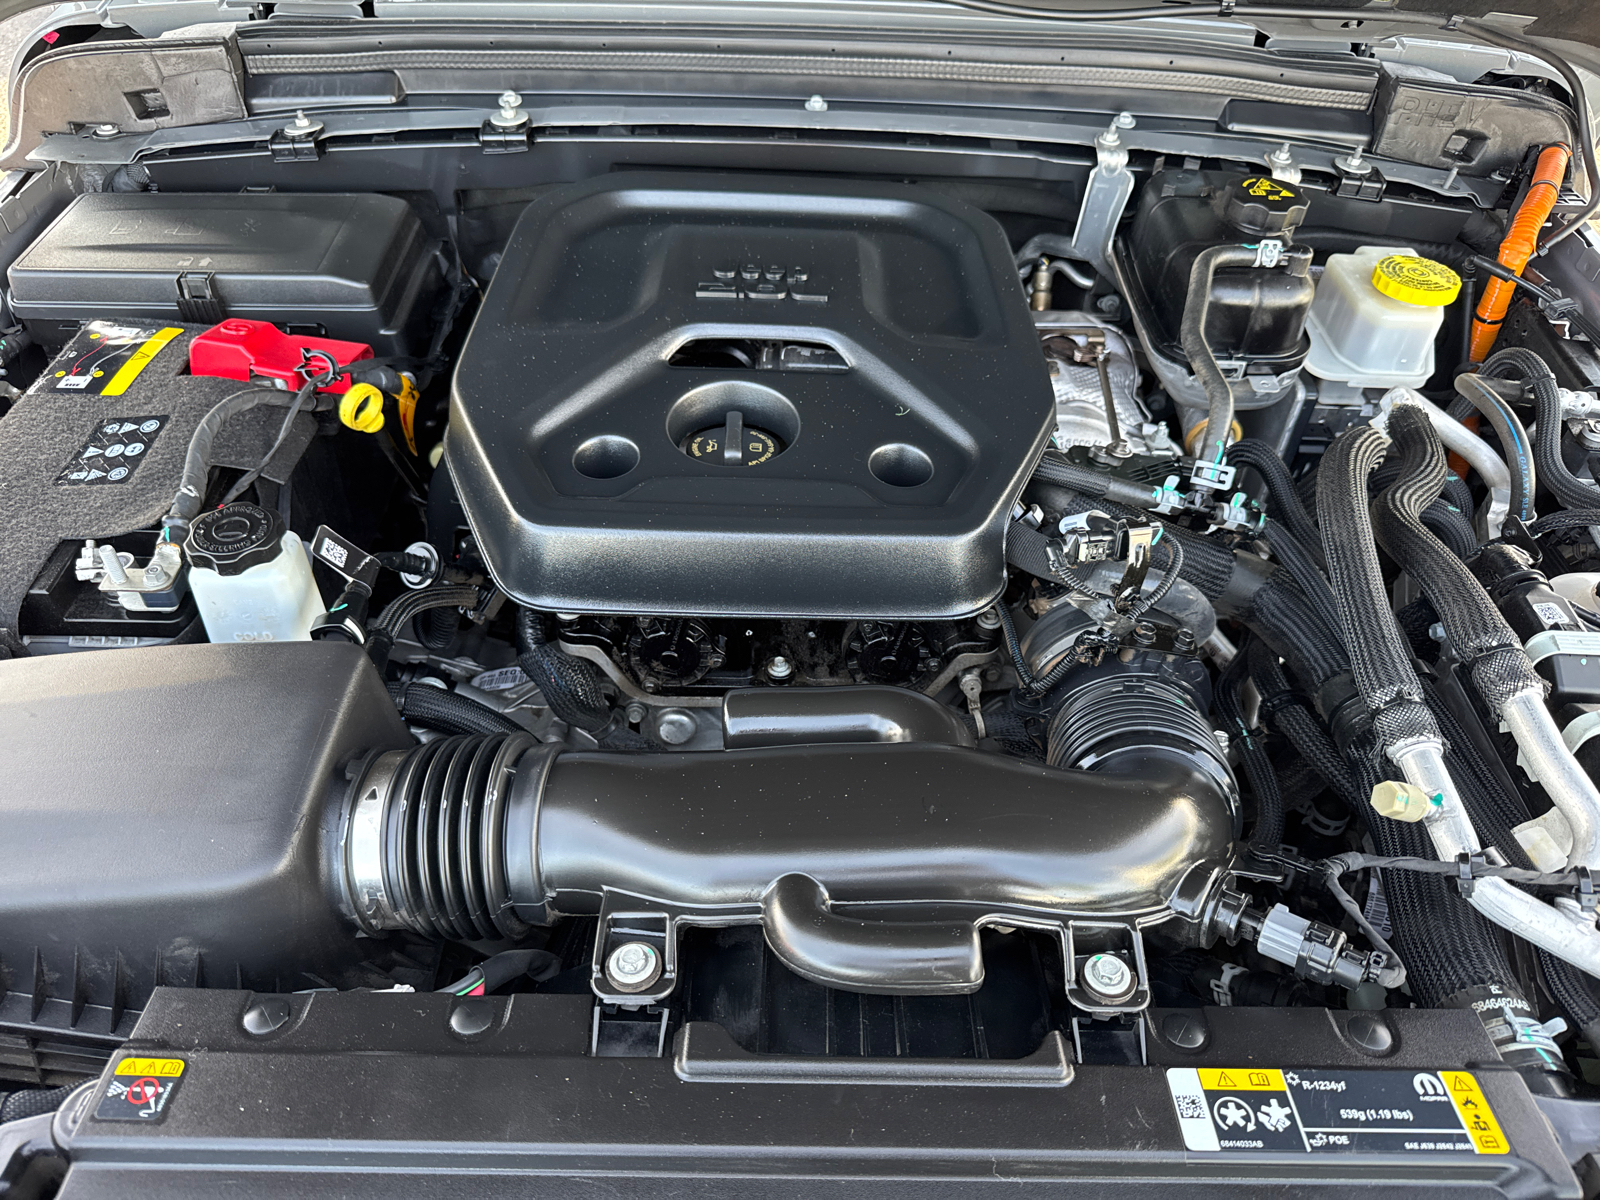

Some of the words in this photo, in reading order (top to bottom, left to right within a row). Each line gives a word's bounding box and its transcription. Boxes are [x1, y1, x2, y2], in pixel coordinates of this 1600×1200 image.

[712, 261, 809, 284] Jeep
[1520, 457, 1529, 495] GALAXY
[234, 631, 273, 641] COLD
[1302, 1081, 1346, 1092] R-1234yf
[1391, 1108, 1414, 1122] lbs)
[1328, 1135, 1350, 1145] POE
